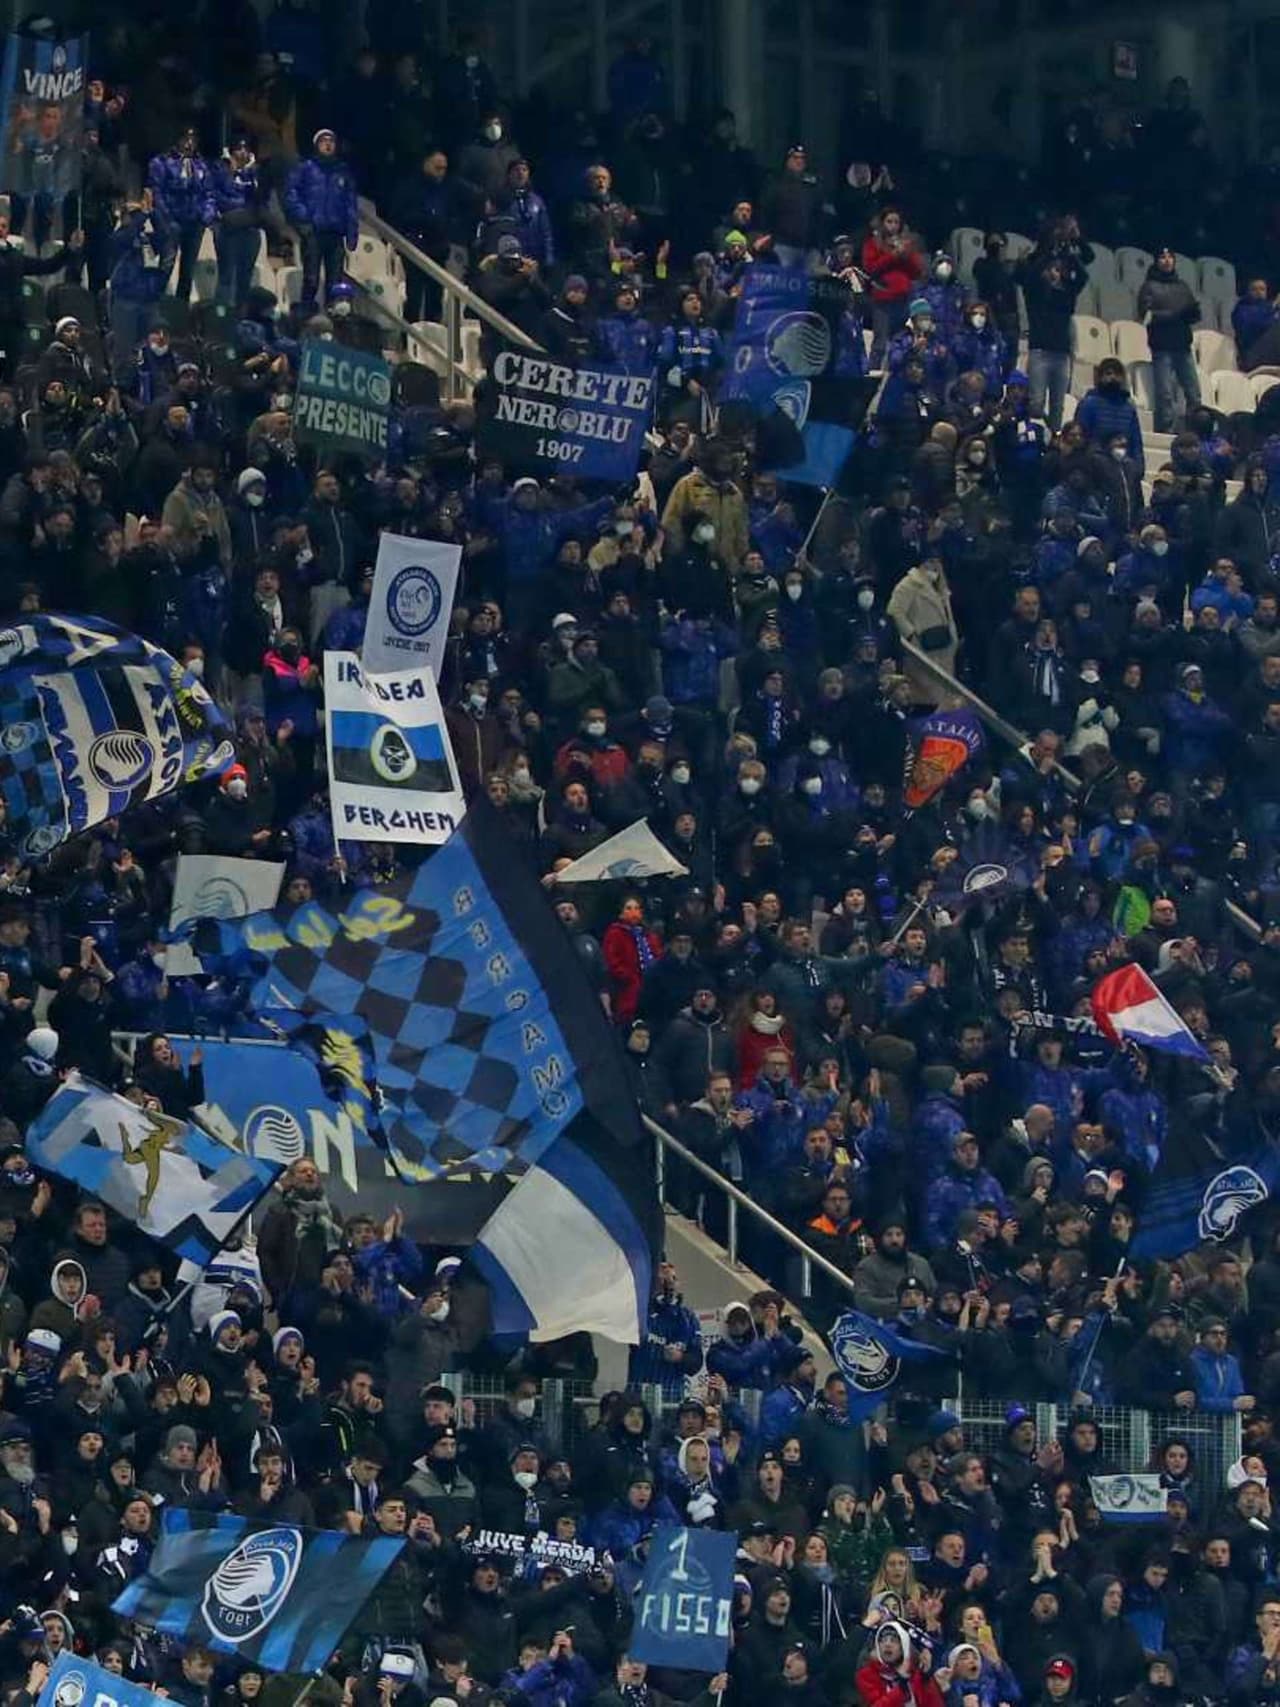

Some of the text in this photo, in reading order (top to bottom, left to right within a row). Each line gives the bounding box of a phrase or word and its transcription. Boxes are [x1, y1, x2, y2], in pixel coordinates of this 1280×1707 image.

[24, 67, 83, 100] VINCE
[494, 351, 652, 410] CERETE
[295, 394, 388, 448] PRESENTE
[536, 439, 585, 462] 1907
[343, 804, 456, 834] BERGHEM
[474, 1529, 525, 1551] JUVE
[668, 1526, 689, 1581] 1
